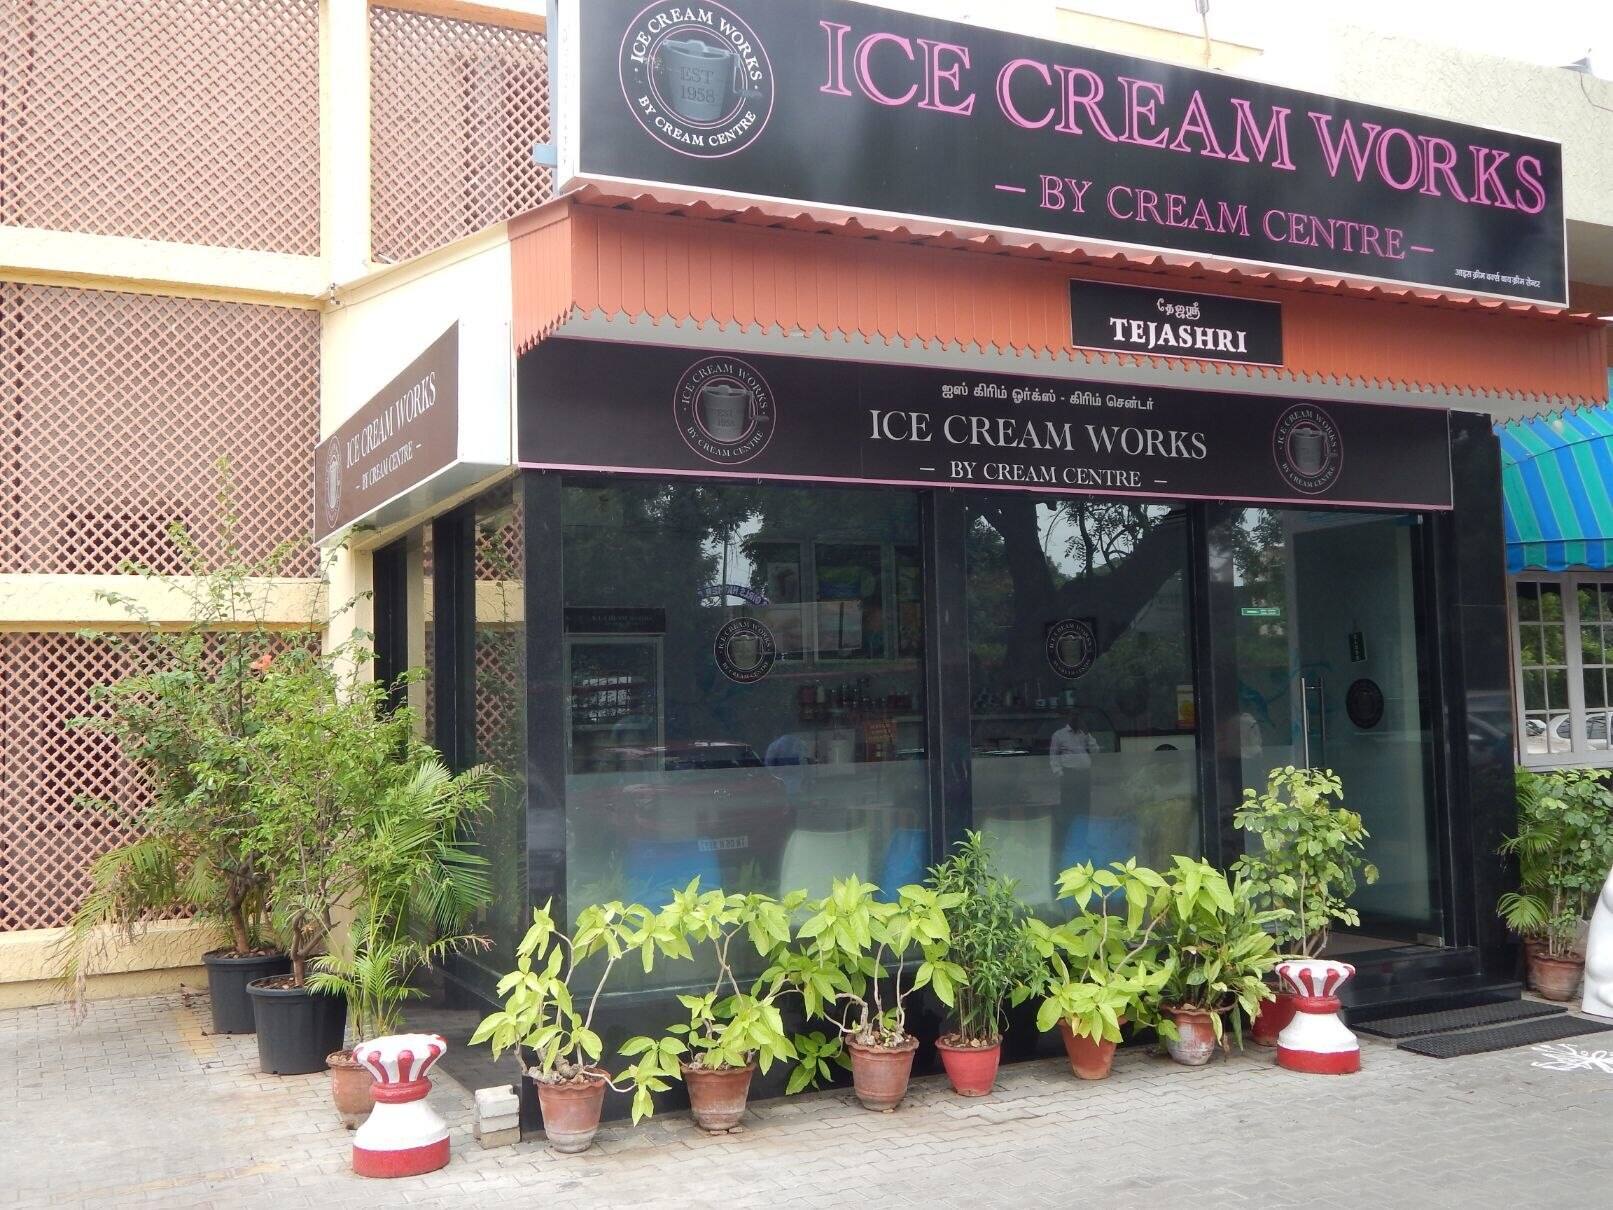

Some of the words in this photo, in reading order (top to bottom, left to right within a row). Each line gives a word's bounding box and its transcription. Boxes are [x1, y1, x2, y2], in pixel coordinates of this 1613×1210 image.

[630, 32, 651, 63] ICE
[648, 8, 713, 33] CREAM
[719, 18, 762, 80] WORKS
[680, 67, 713, 84] EST
[681, 86, 716, 104] 1958
[638, 96, 656, 115] BY
[655, 117, 704, 146] CREAM
[708, 111, 756, 146] CENTRE
[820, 21, 976, 116] ICE
[996, 58, 1295, 171] CREAM
[1309, 111, 1546, 215] WORKS
[1040, 175, 1091, 213] BY
[1107, 186, 1250, 238] CREAM
[1263, 210, 1406, 260] CENTRE
[1109, 317, 1248, 353] TEJASHRI
[681, 383, 695, 404] ICE
[692, 363, 734, 383] CREAM
[738, 368, 767, 409] WORKS
[346, 433, 360, 469] ICE
[361, 406, 393, 456] CREAM
[395, 371, 436, 430] WORKS
[869, 409, 932, 442] ICE
[943, 414, 1075, 451] CREAM
[1084, 424, 1208, 460] WORKS
[950, 460, 978, 479] BY
[983, 462, 1056, 484] CREAM
[1063, 467, 1142, 488] CENTRE
